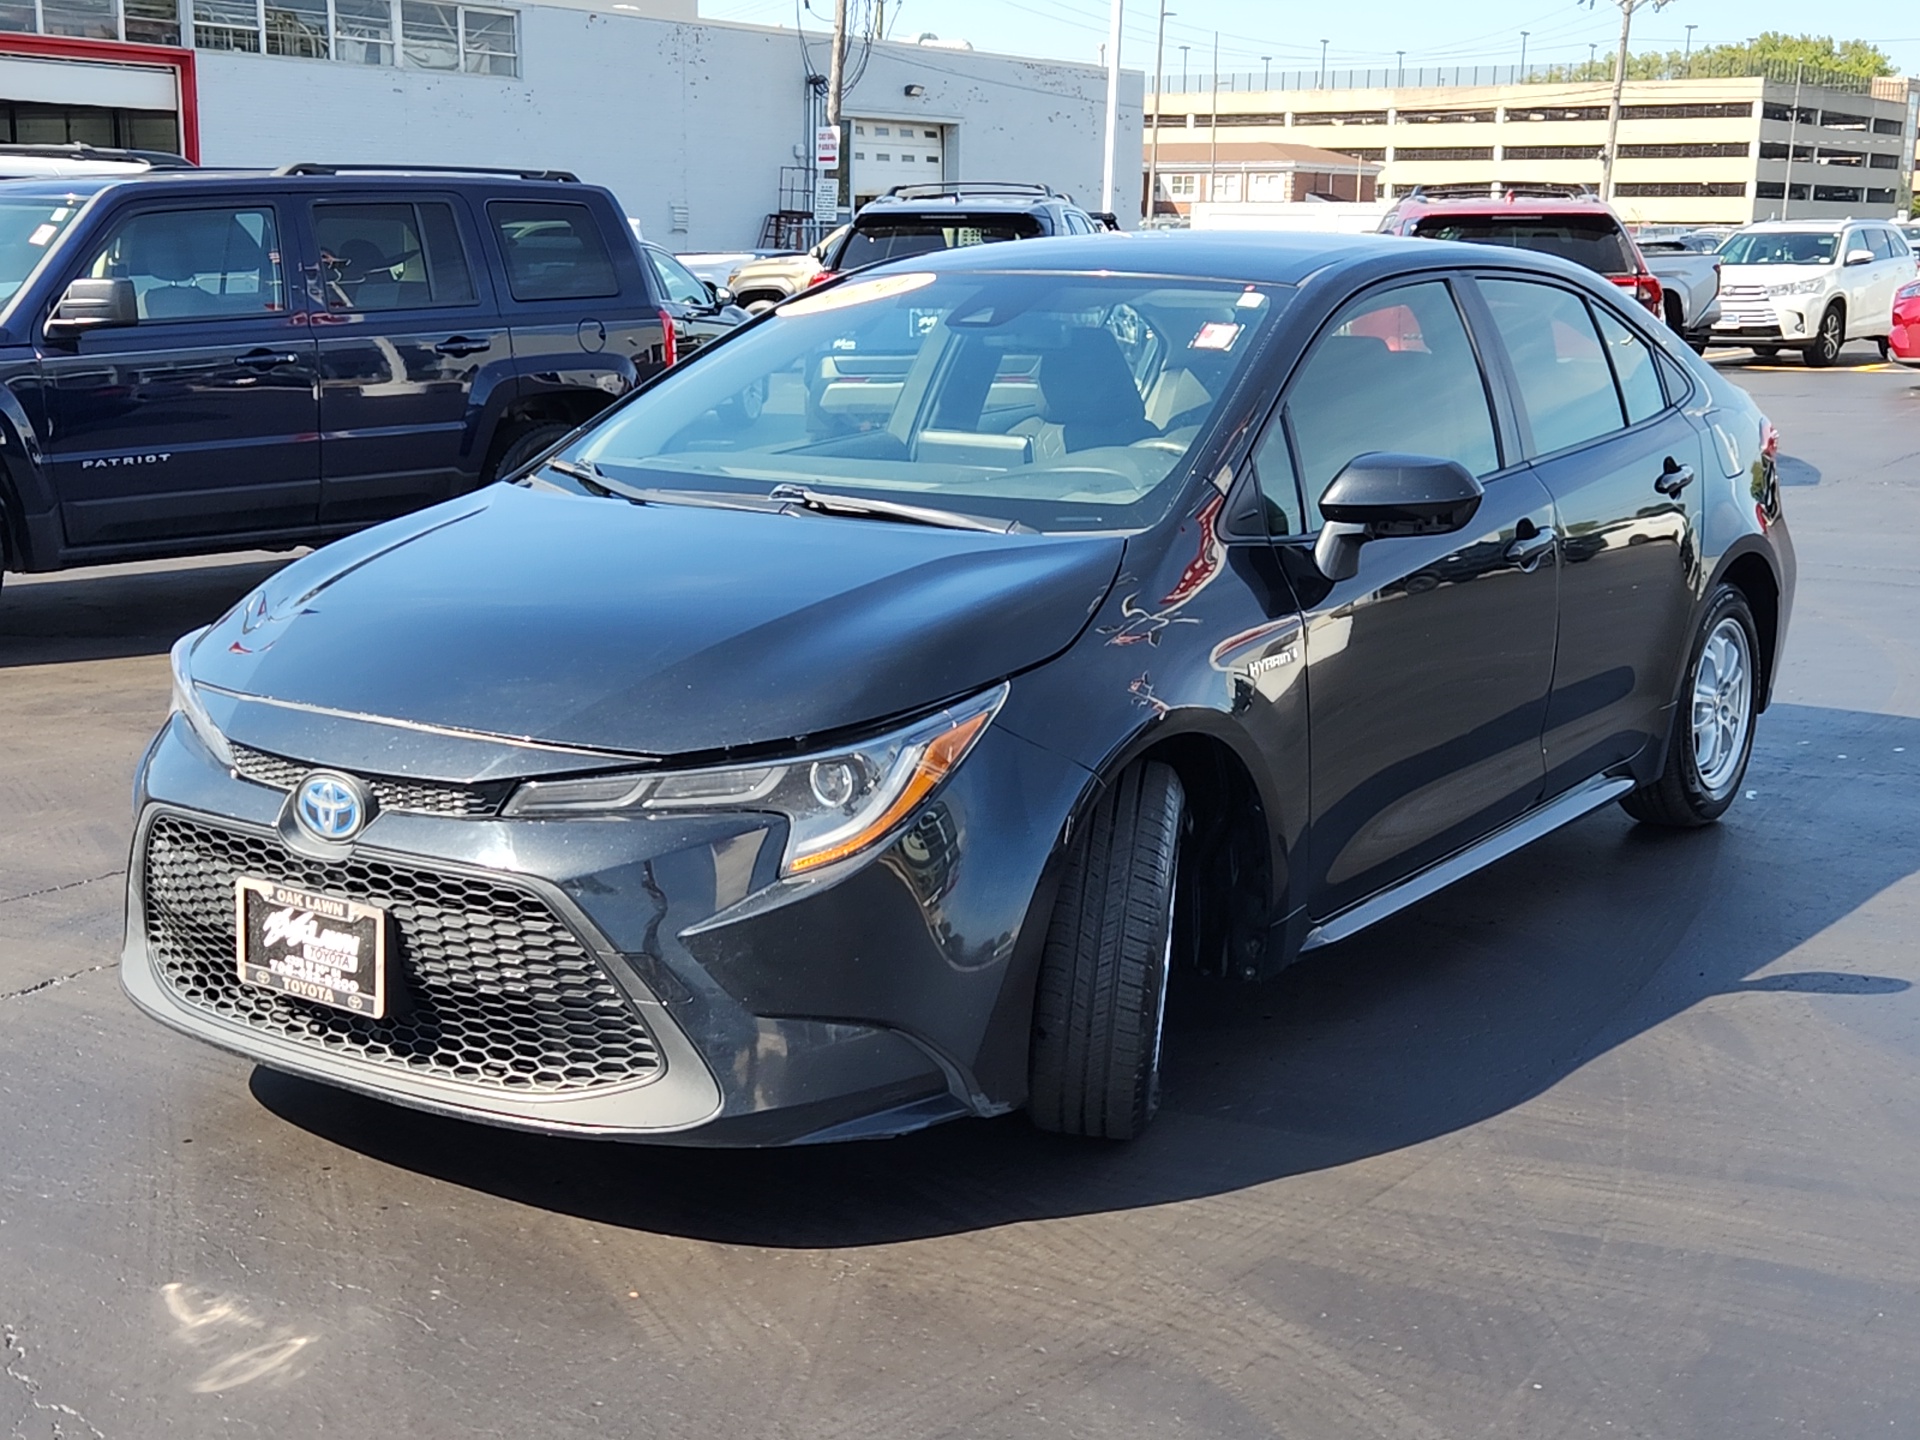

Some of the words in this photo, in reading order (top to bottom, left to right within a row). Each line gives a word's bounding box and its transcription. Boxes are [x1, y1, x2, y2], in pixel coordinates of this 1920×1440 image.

[82, 453, 171, 469] PATRIOT
[276, 888, 304, 907] OAK
[305, 895, 344, 917] LAWN
[310, 947, 350, 970] TOYOTA
[282, 977, 335, 1003] TOYOTA
